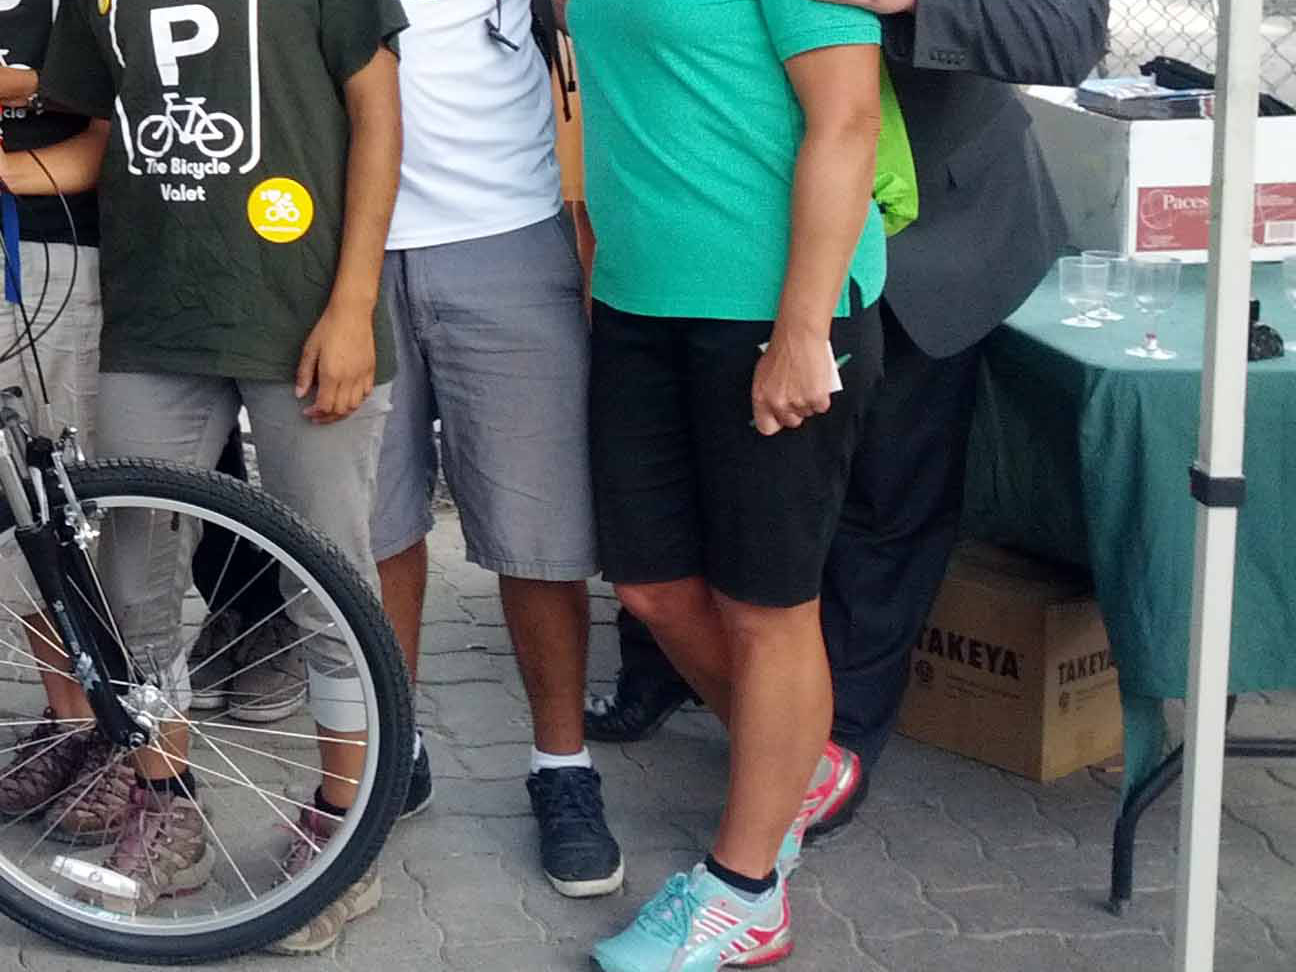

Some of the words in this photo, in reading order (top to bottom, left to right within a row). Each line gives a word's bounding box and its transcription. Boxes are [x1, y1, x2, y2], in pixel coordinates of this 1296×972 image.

[150, 3, 220, 86] P
[144, 157, 168, 175] The
[170, 156, 232, 179] Bicycle
[160, 183, 207, 202] Valet
